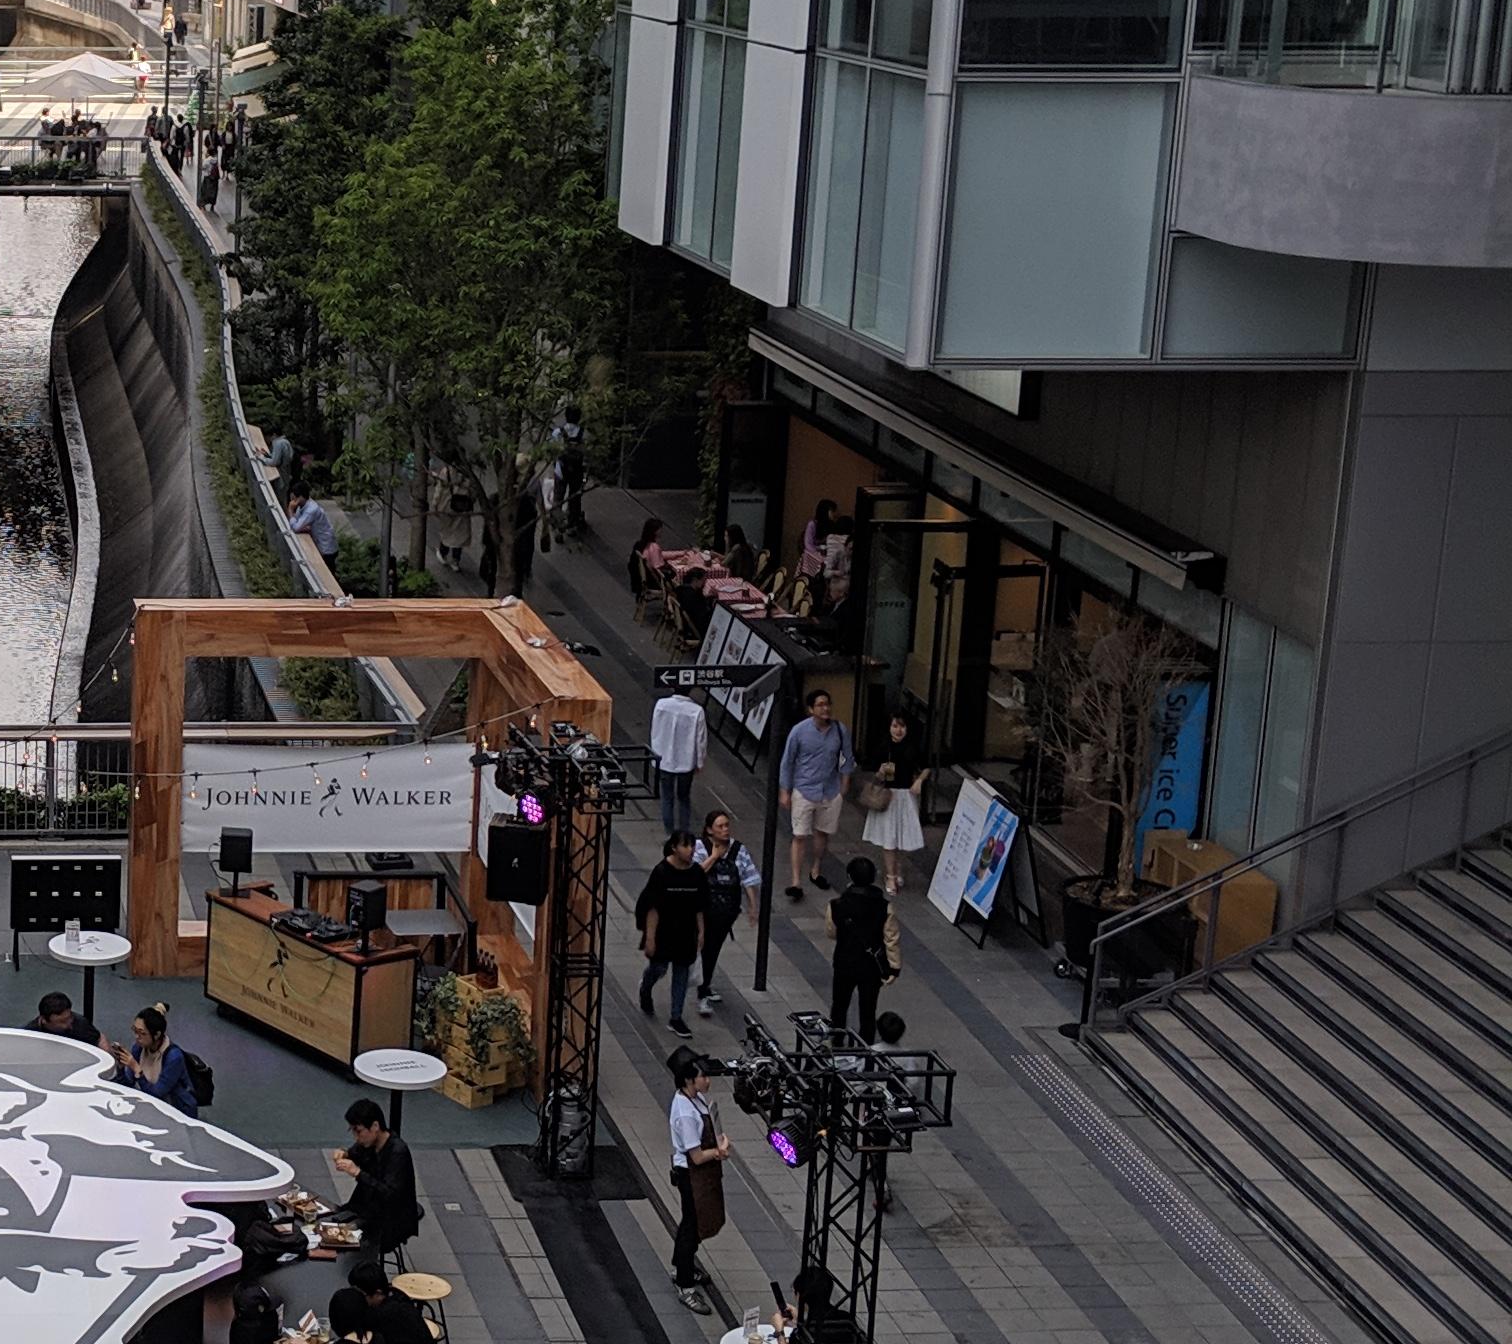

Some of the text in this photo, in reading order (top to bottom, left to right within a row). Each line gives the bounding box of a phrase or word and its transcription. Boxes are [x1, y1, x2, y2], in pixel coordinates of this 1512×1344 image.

[1156, 768, 1181, 802] ice
[201, 787, 452, 811] JOHNNIE WALKER
[279, 1003, 316, 1028] WALKER
